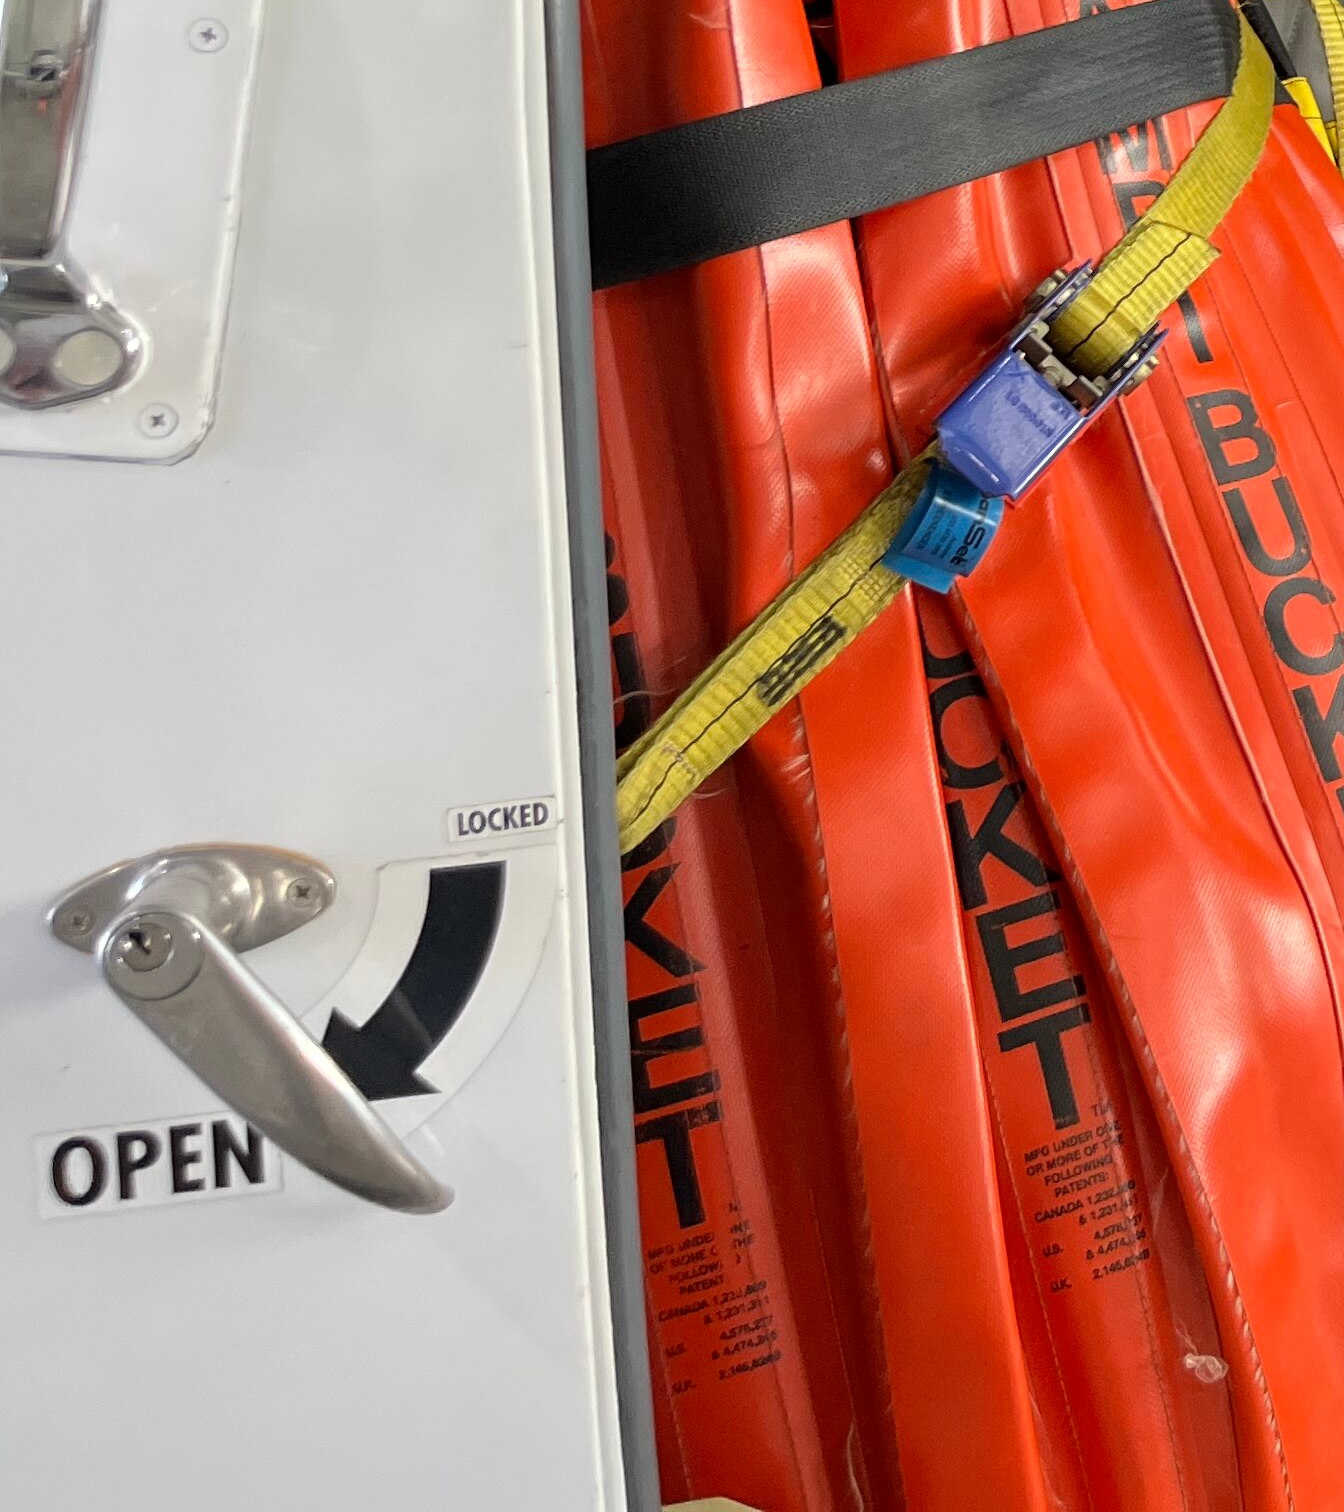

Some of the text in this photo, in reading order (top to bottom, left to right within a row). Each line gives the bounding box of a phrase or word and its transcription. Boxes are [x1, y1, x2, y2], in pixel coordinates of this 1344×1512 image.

[456, 801, 550, 837] LOCKED
[1053, 1129, 1094, 1152] UNDER
[50, 1120, 265, 1208] OPEN
[1026, 1163, 1044, 1177] OR
[1046, 1151, 1081, 1171] MORE
[1085, 1144, 1100, 1159] OF
[1034, 1199, 1083, 1223] CANADA
